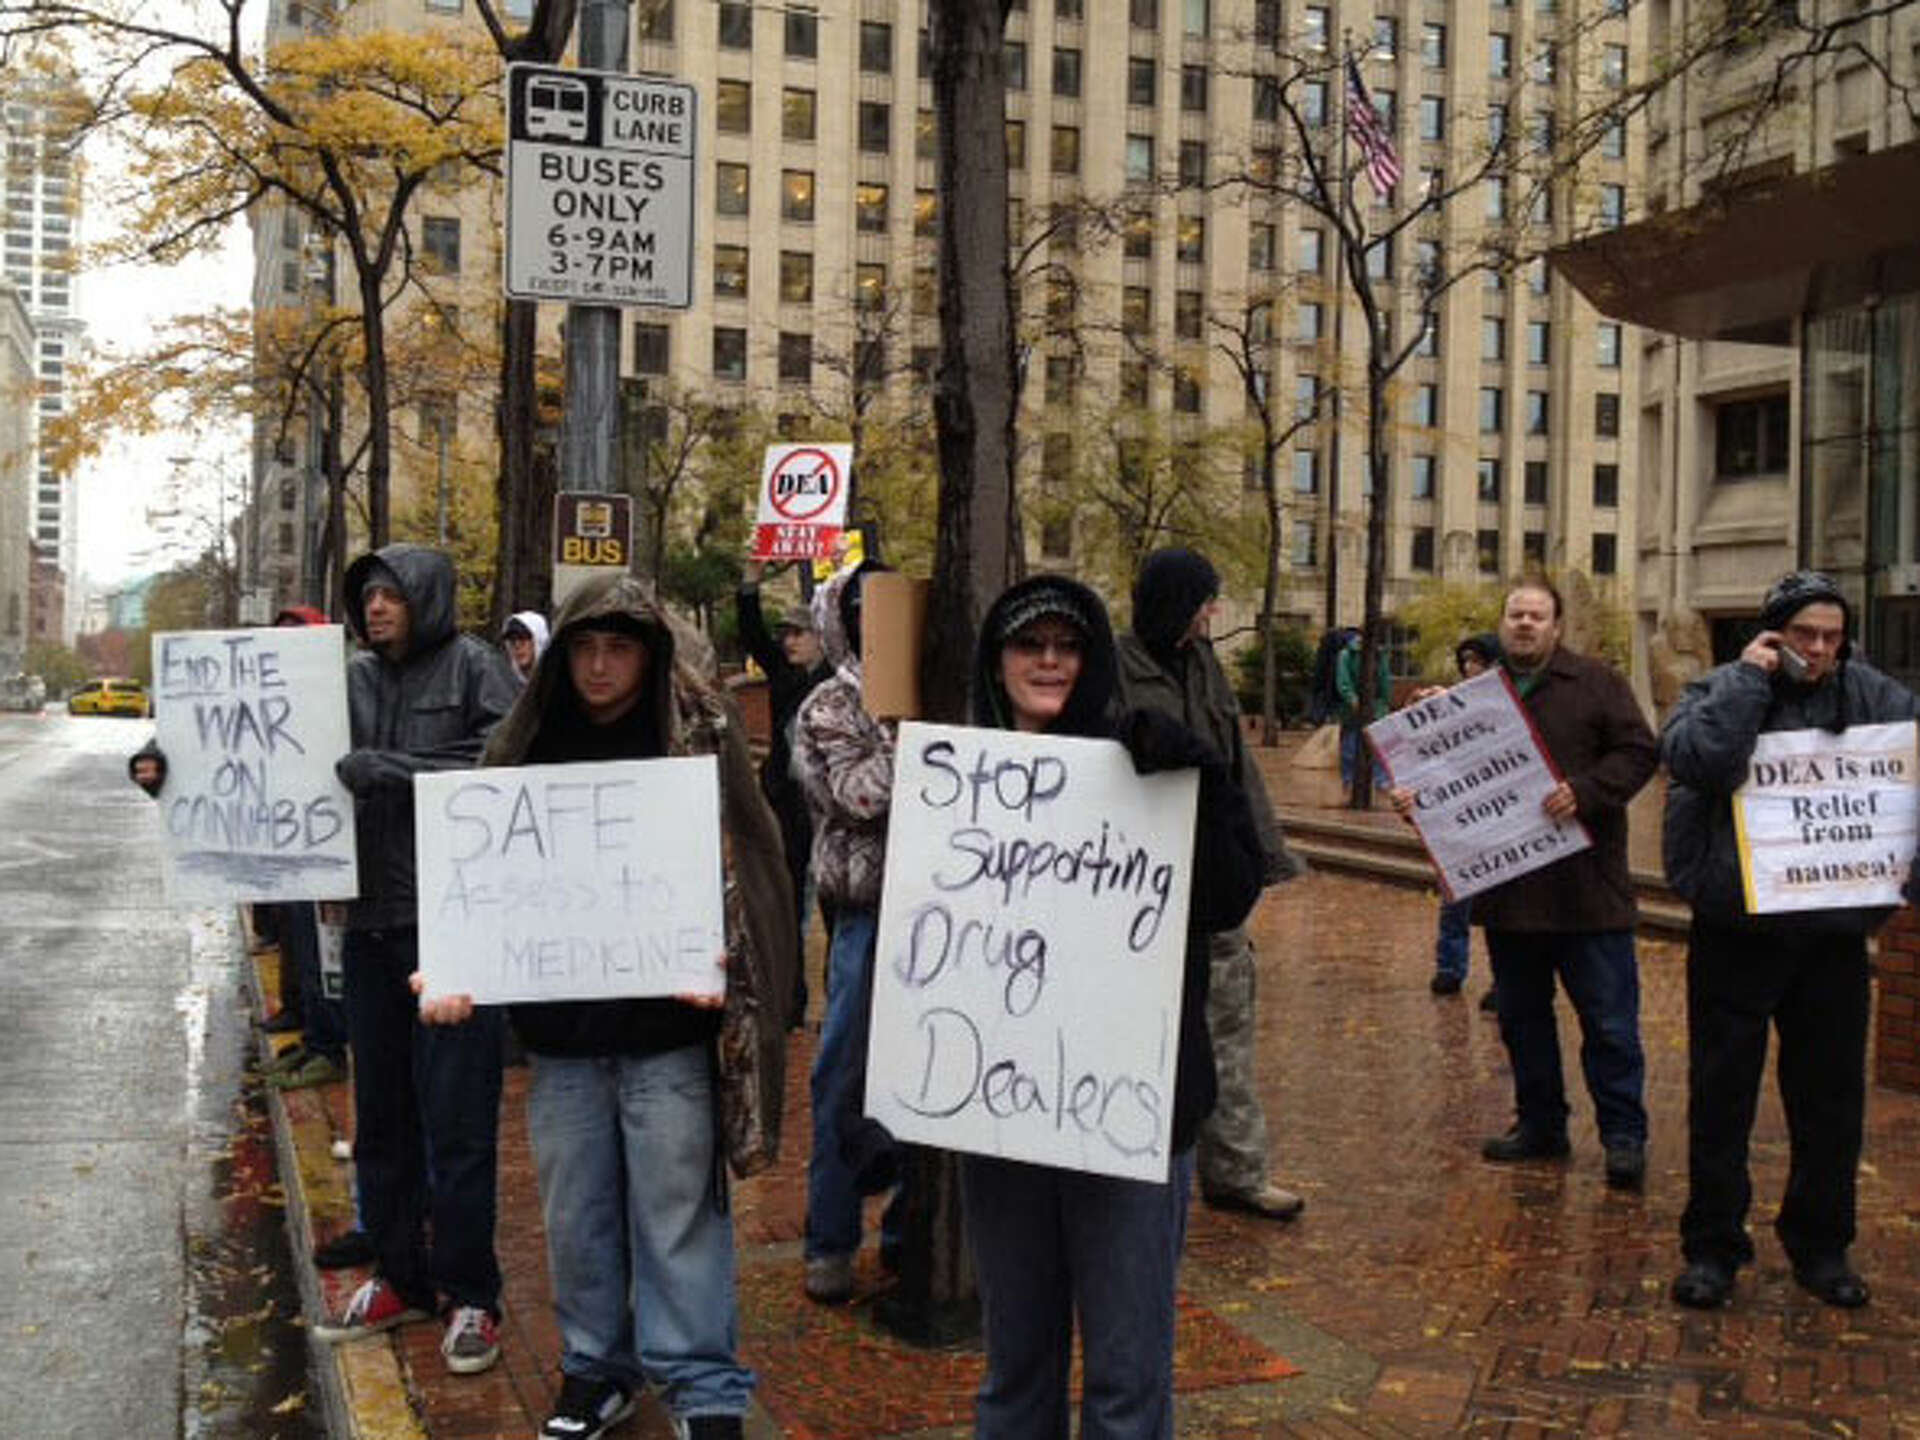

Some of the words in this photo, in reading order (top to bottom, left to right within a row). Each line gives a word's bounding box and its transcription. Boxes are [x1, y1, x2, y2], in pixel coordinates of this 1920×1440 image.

[613, 89, 685, 115] CURB
[613, 119, 683, 144] LANE
[540, 152, 665, 191] BUSES
[553, 189, 649, 223] ONLY
[777, 473, 829, 494] DEA
[562, 535, 622, 564] BUS
[194, 695, 305, 755] WAR
[1404, 693, 1468, 731] DEA
[212, 757, 267, 802] ON
[920, 740, 1068, 823] Stop
[1414, 748, 1532, 811] Cannabis
[1754, 758, 1826, 788] DEA
[1834, 756, 1861, 781] is
[1869, 757, 1906, 778] no
[167, 795, 343, 850] CANNABIS
[445, 778, 638, 864] SAFE
[1453, 788, 1521, 829] stops
[1791, 789, 1881, 821] Relief
[1800, 821, 1874, 846] from
[1786, 851, 1899, 885] nausea!
[894, 904, 1048, 1017] Drug
